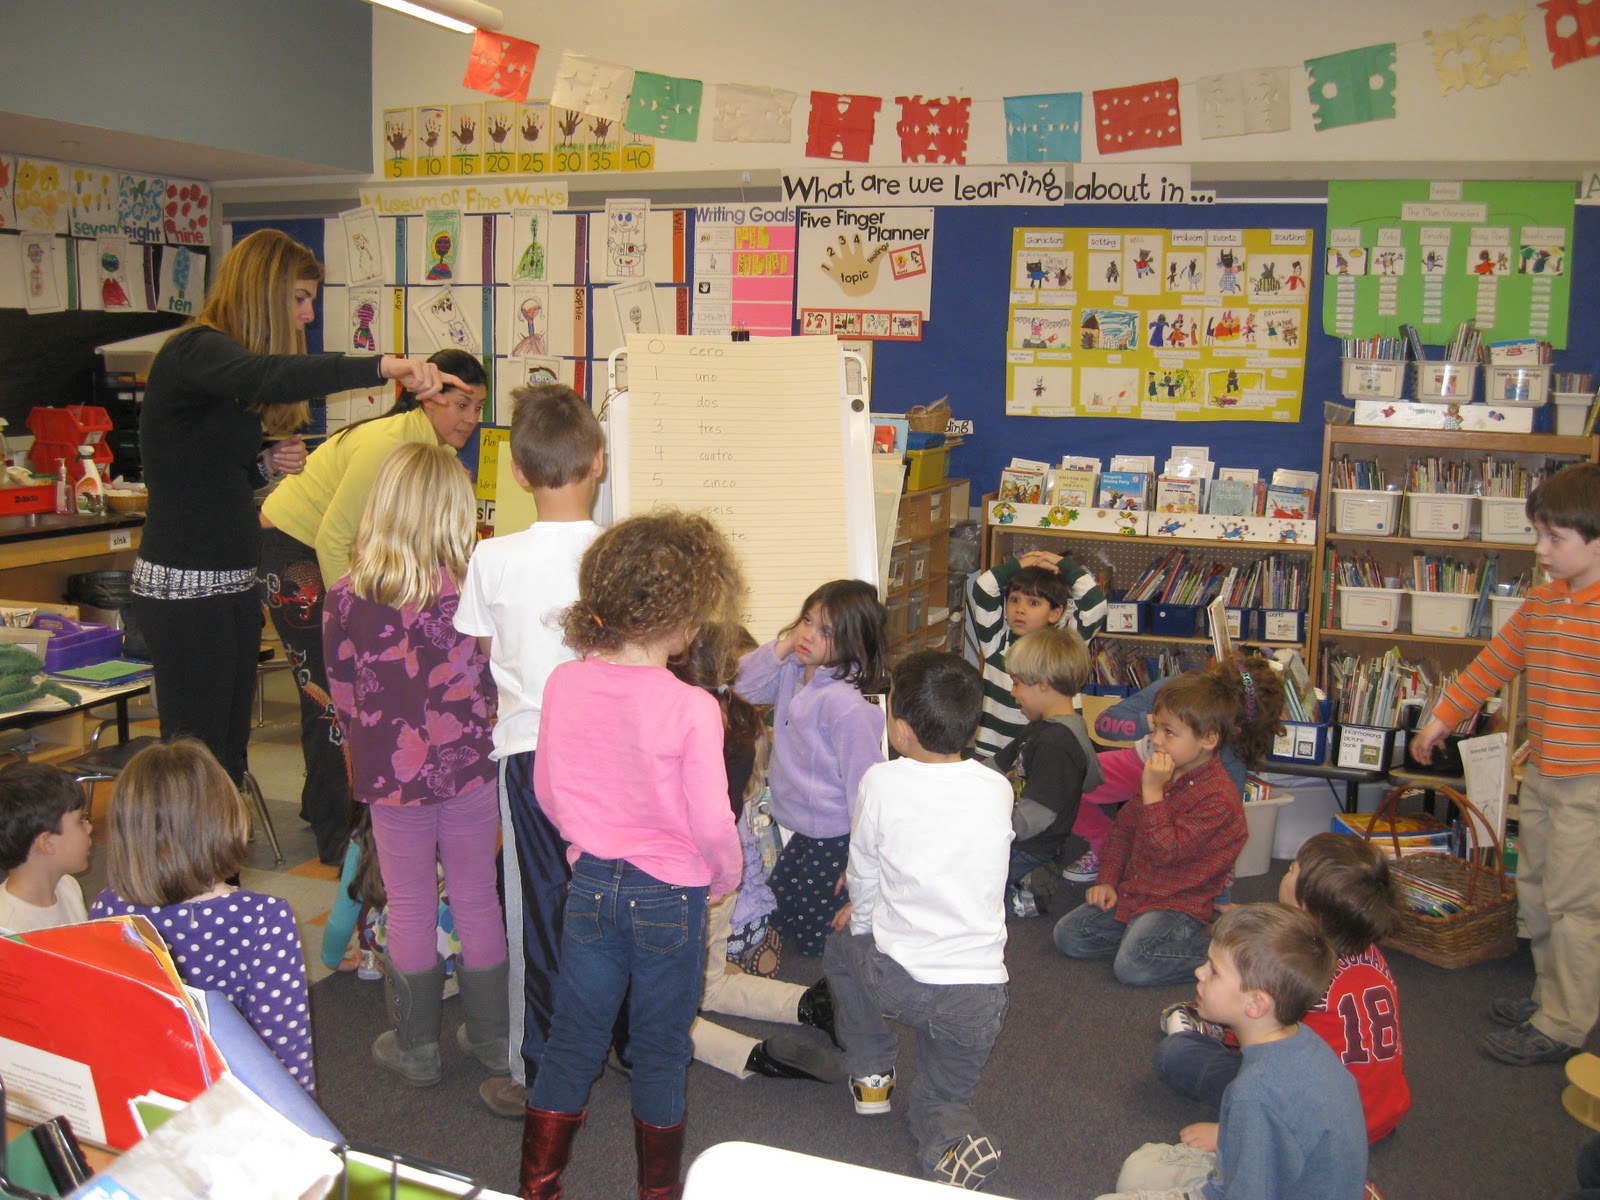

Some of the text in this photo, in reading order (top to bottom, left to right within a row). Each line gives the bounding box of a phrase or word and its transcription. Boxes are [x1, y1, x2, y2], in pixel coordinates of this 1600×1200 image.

[425, 158, 441, 175] 10
[460, 158, 473, 175] 15
[487, 155, 510, 173] 20
[521, 153, 544, 172] 25
[557, 152, 581, 172] 30
[588, 152, 611, 171] 35
[626, 150, 650, 168] 40
[393, 162, 402, 177] 5
[782, 170, 855, 203] What
[861, 174, 900, 195] are
[909, 176, 944, 194] we
[954, 168, 1063, 202] Learning
[1074, 172, 1150, 201] about
[466, 187, 500, 210] Fine
[503, 186, 565, 208] Works
[673, 211, 684, 236] Will
[695, 206, 796, 225] Writing Goals
[800, 210, 885, 230] Five Finger
[74, 222, 117, 237] seven
[124, 222, 161, 243] eight
[174, 227, 204, 244] nine
[868, 226, 930, 242] Planner
[839, 235, 847, 245] 3
[853, 234, 861, 245] 4
[827, 247, 836, 257] 2
[840, 270, 870, 286] topic
[169, 295, 193, 312] ten
[394, 288, 403, 310] Lucy
[575, 288, 585, 321] Sophie
[690, 346, 724, 358] cero
[696, 372, 717, 382] uno
[653, 392, 719, 408] 2 dos
[653, 418, 722, 435] 3 tres
[654, 446, 664, 460] 4
[652, 473, 736, 488] 5 cinco
[707, 505, 734, 515] seis
[113, 536, 127, 546] sink
[1096, 716, 1136, 736] ove
[1337, 985, 1399, 1064] 18
